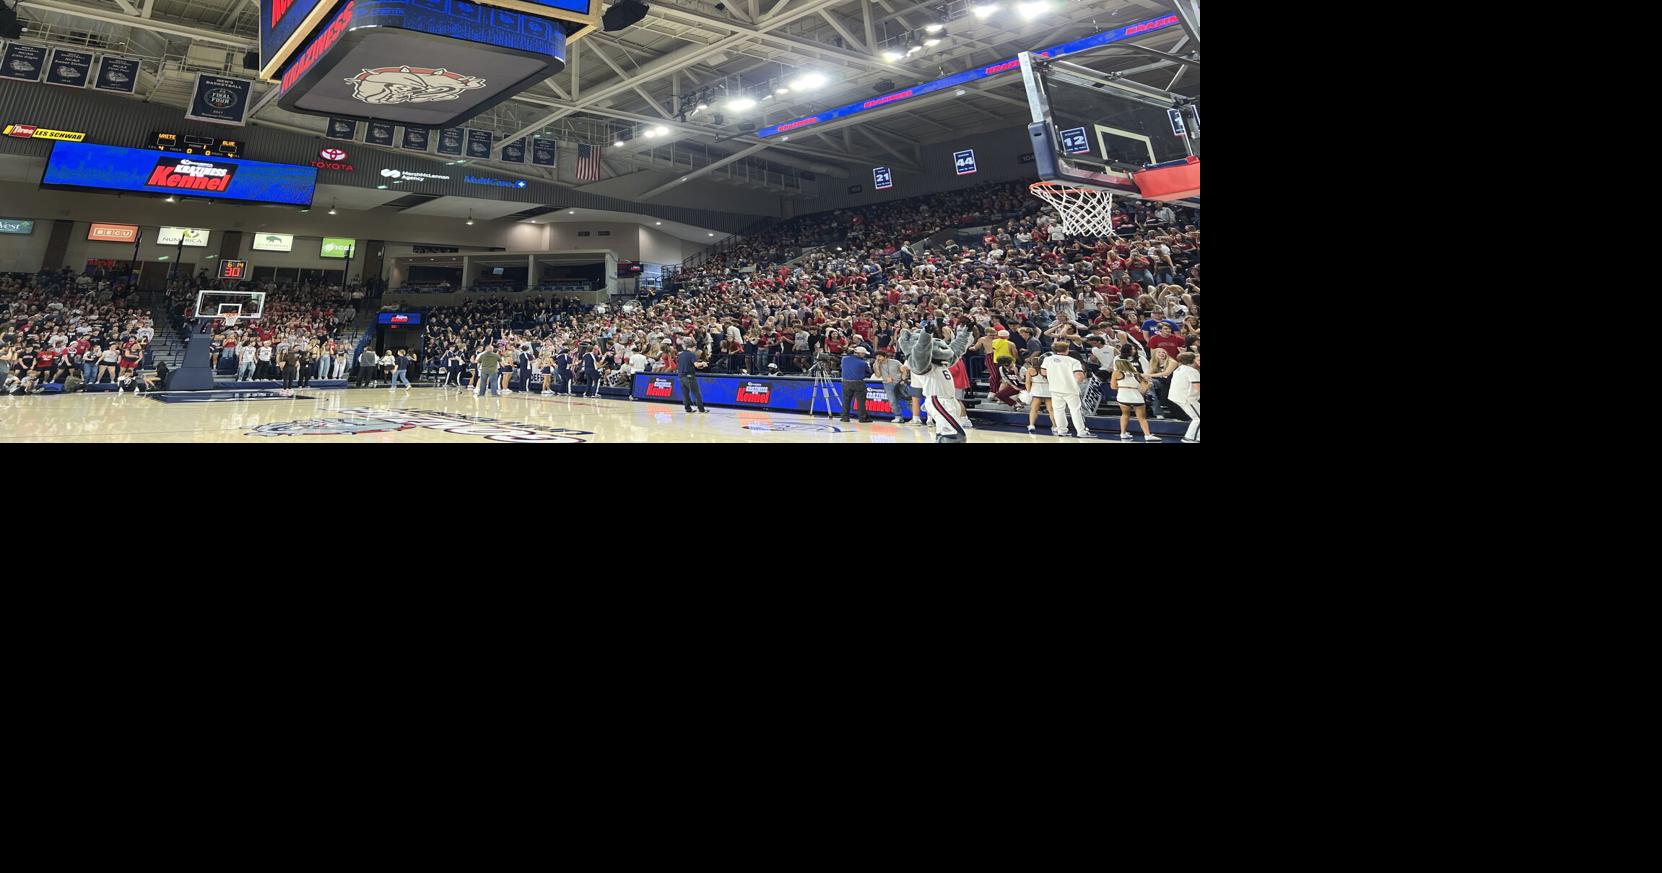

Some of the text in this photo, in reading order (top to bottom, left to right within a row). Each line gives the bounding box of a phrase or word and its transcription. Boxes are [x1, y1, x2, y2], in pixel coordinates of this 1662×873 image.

[49, 132, 83, 140] SCHWAB
[1064, 135, 1085, 147] 12
[309, 161, 353, 171] TOYOTA
[957, 157, 974, 167] 44
[148, 166, 231, 191] Kennel
[876, 173, 889, 182] 21
[225, 267, 240, 277] 30
[943, 369, 952, 380] 6
[736, 387, 770, 403] Kennel
